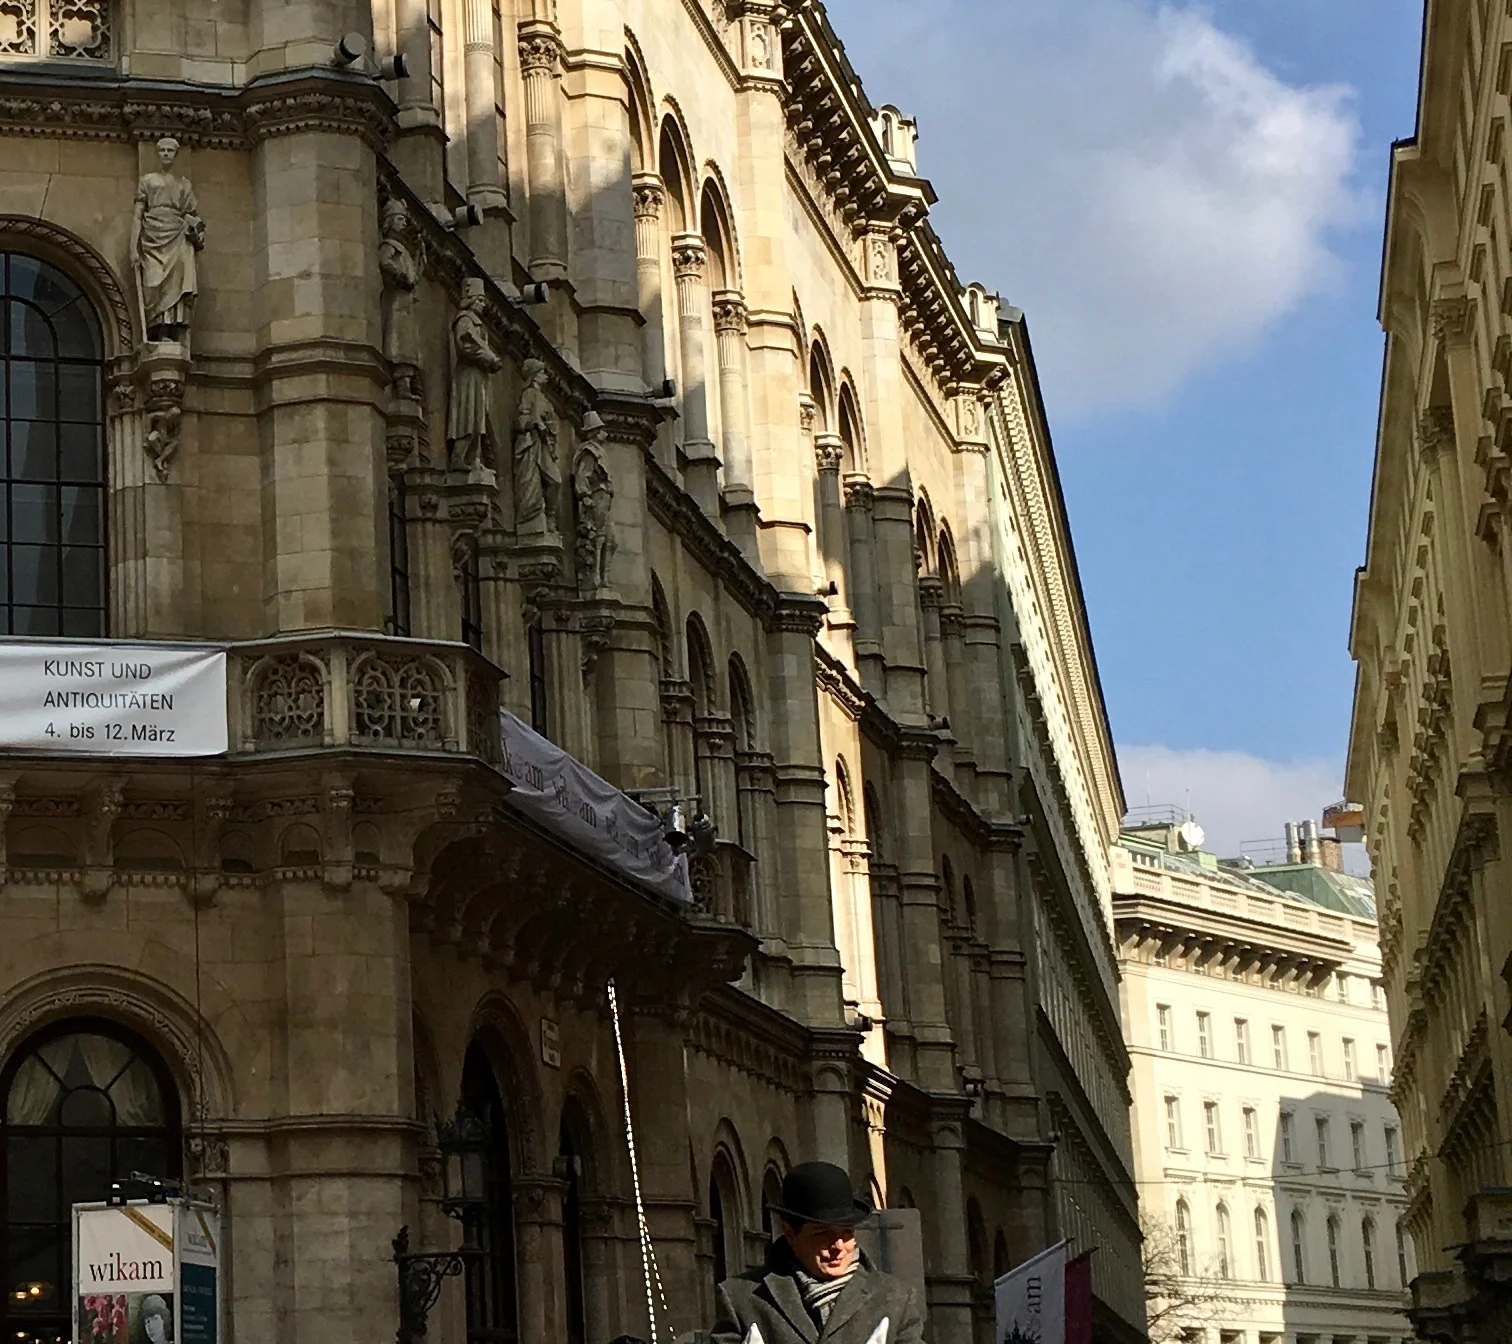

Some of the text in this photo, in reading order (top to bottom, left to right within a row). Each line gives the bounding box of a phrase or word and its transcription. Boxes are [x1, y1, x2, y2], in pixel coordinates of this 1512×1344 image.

[44, 659, 152, 680] KUNST UND
[43, 688, 174, 711] ANTIQUITÄTEN
[44, 722, 62, 738] 4.
[70, 722, 95, 739] bis
[89, 1253, 164, 1282] wikam
